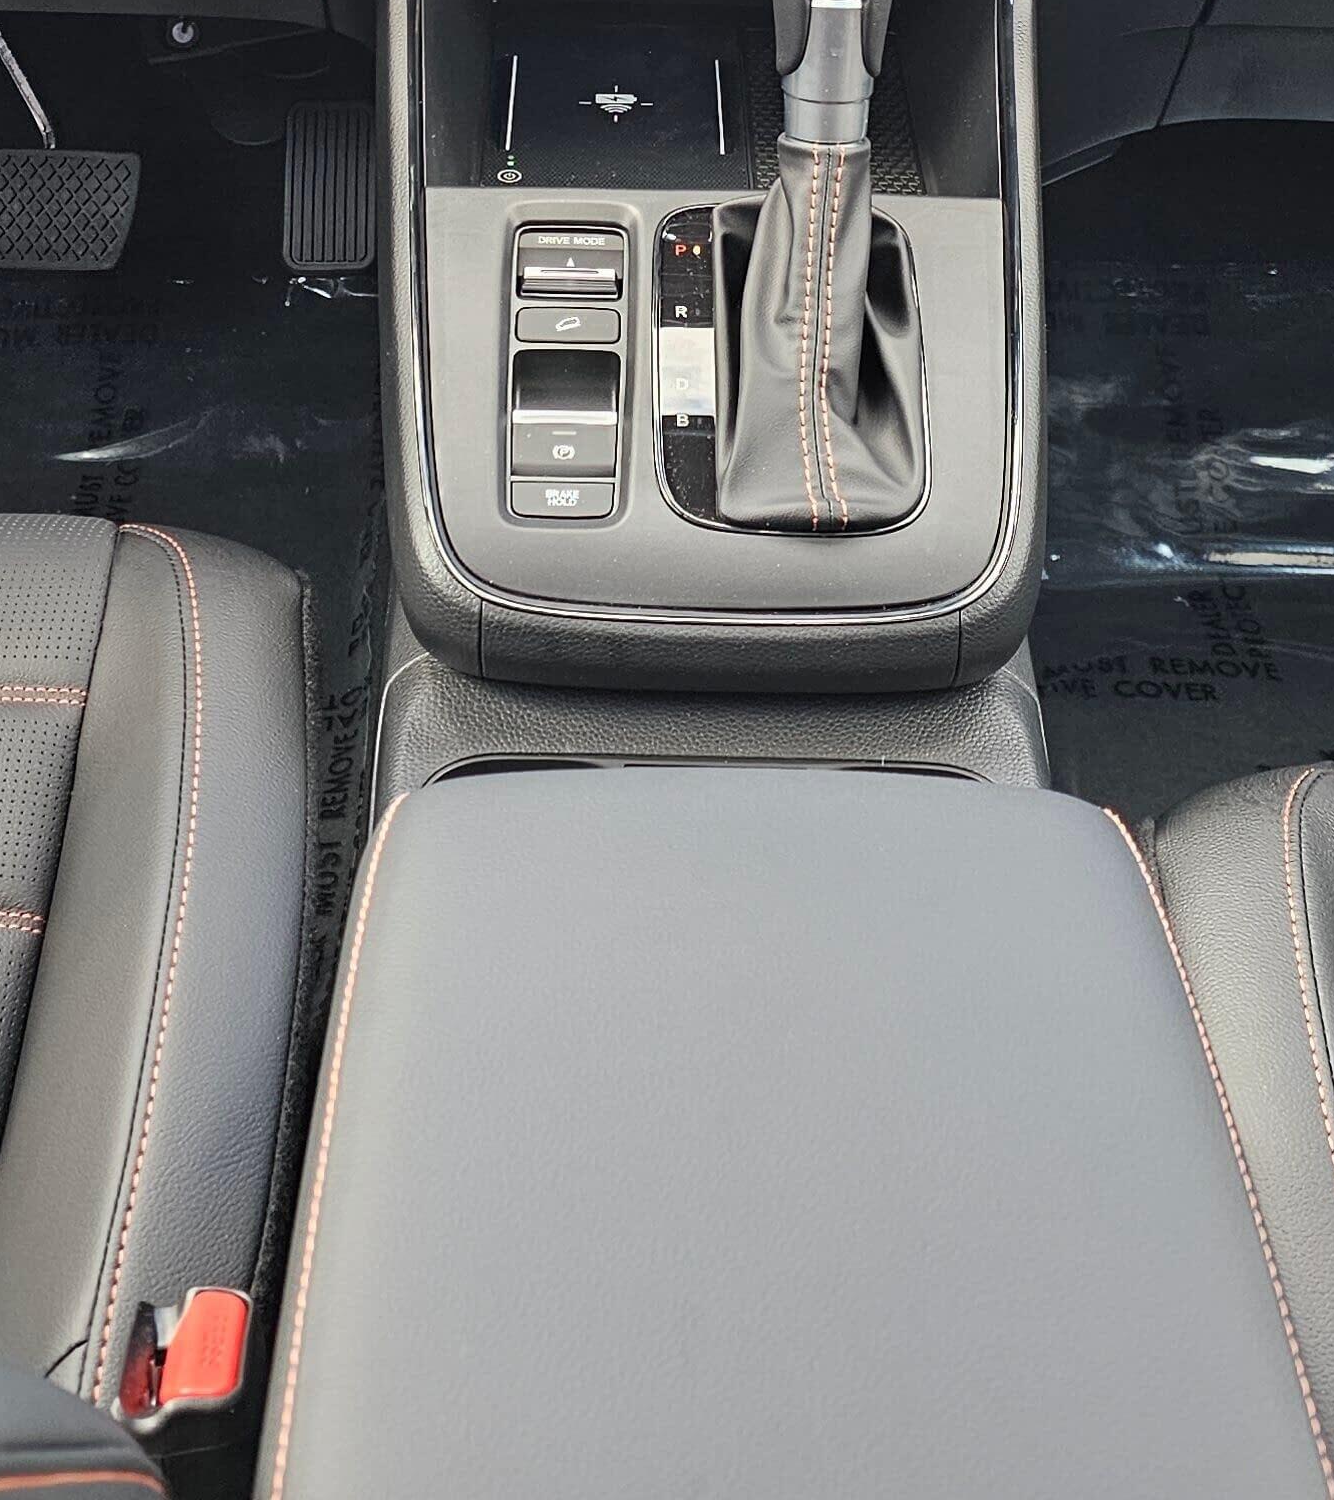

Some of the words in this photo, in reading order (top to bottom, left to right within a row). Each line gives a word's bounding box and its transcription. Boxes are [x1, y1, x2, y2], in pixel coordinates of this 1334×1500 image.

[538, 236, 571, 245] DRIVE
[573, 237, 606, 246] MODE
[675, 245, 687, 256] P
[675, 306, 688, 318] R
[675, 378, 689, 391] D
[676, 414, 689, 427] B
[545, 489, 580, 500] BRAKE
[547, 497, 578, 507] HOLD
[1149, 656, 1284, 683] REMOVE
[1113, 679, 1221, 704] COVER
